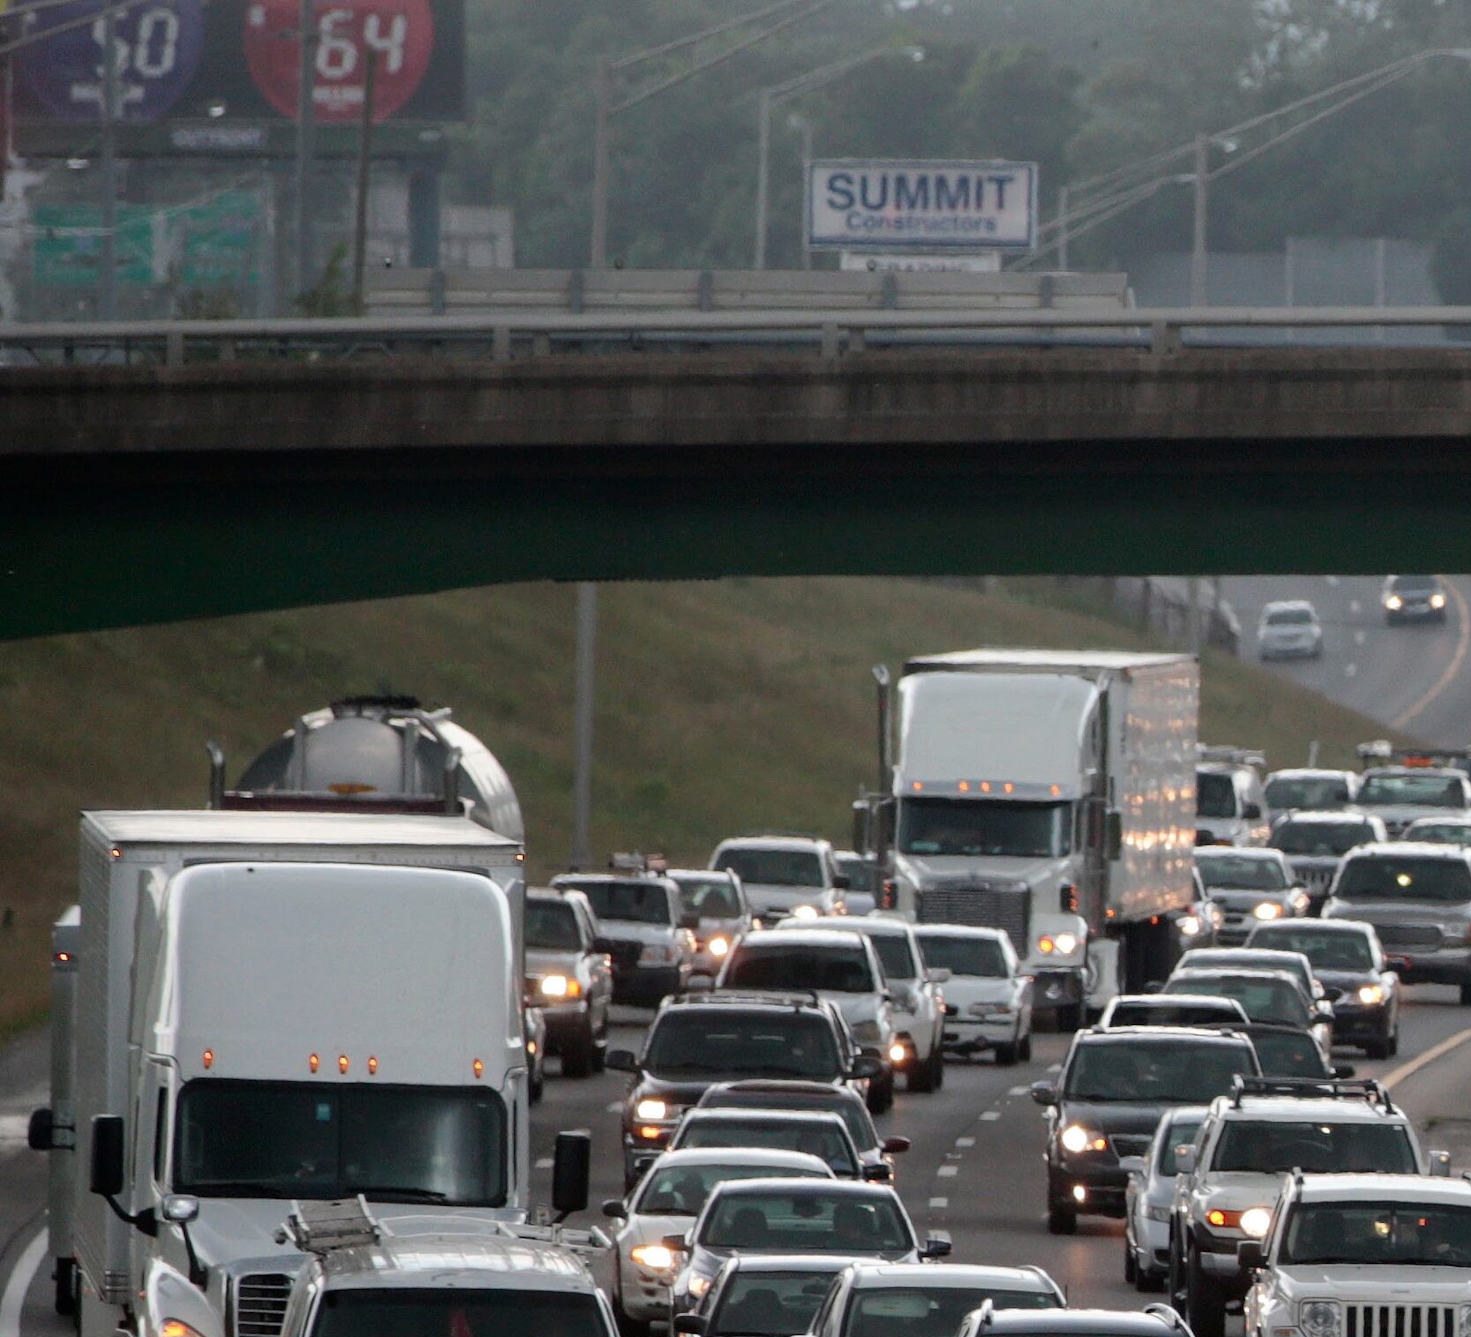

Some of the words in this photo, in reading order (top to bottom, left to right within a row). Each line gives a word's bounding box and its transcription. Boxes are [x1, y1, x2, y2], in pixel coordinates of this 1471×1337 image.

[316, 9, 407, 78] 64
[826, 171, 1014, 212] SUMMIT
[846, 211, 996, 232] Constructors
